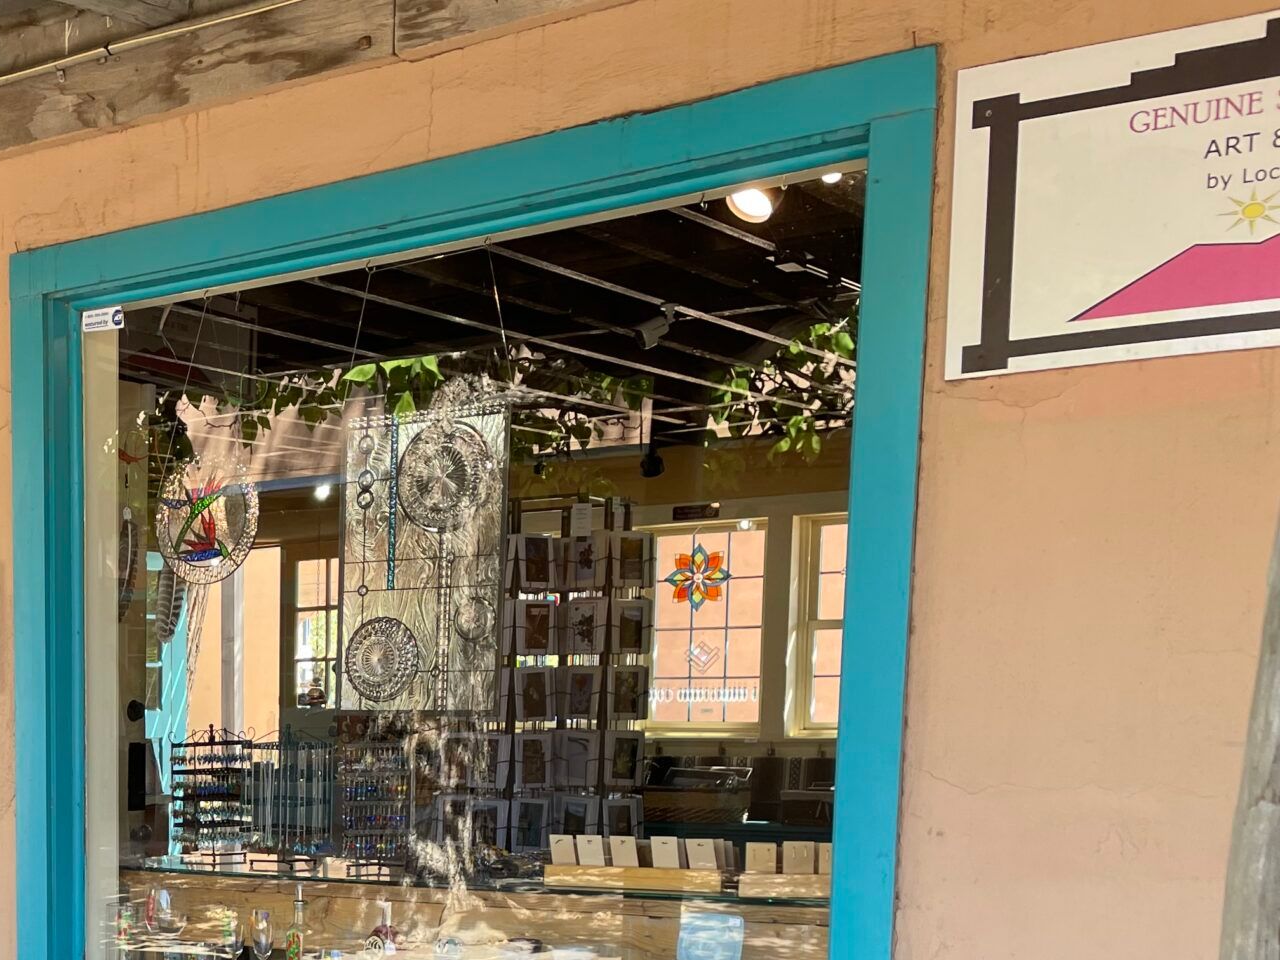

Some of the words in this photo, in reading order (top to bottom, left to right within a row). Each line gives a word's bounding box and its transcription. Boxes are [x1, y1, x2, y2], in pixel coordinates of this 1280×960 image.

[1129, 91, 1264, 133] GENUINE
[1204, 132, 1261, 159] ART
[1206, 172, 1232, 191] by
